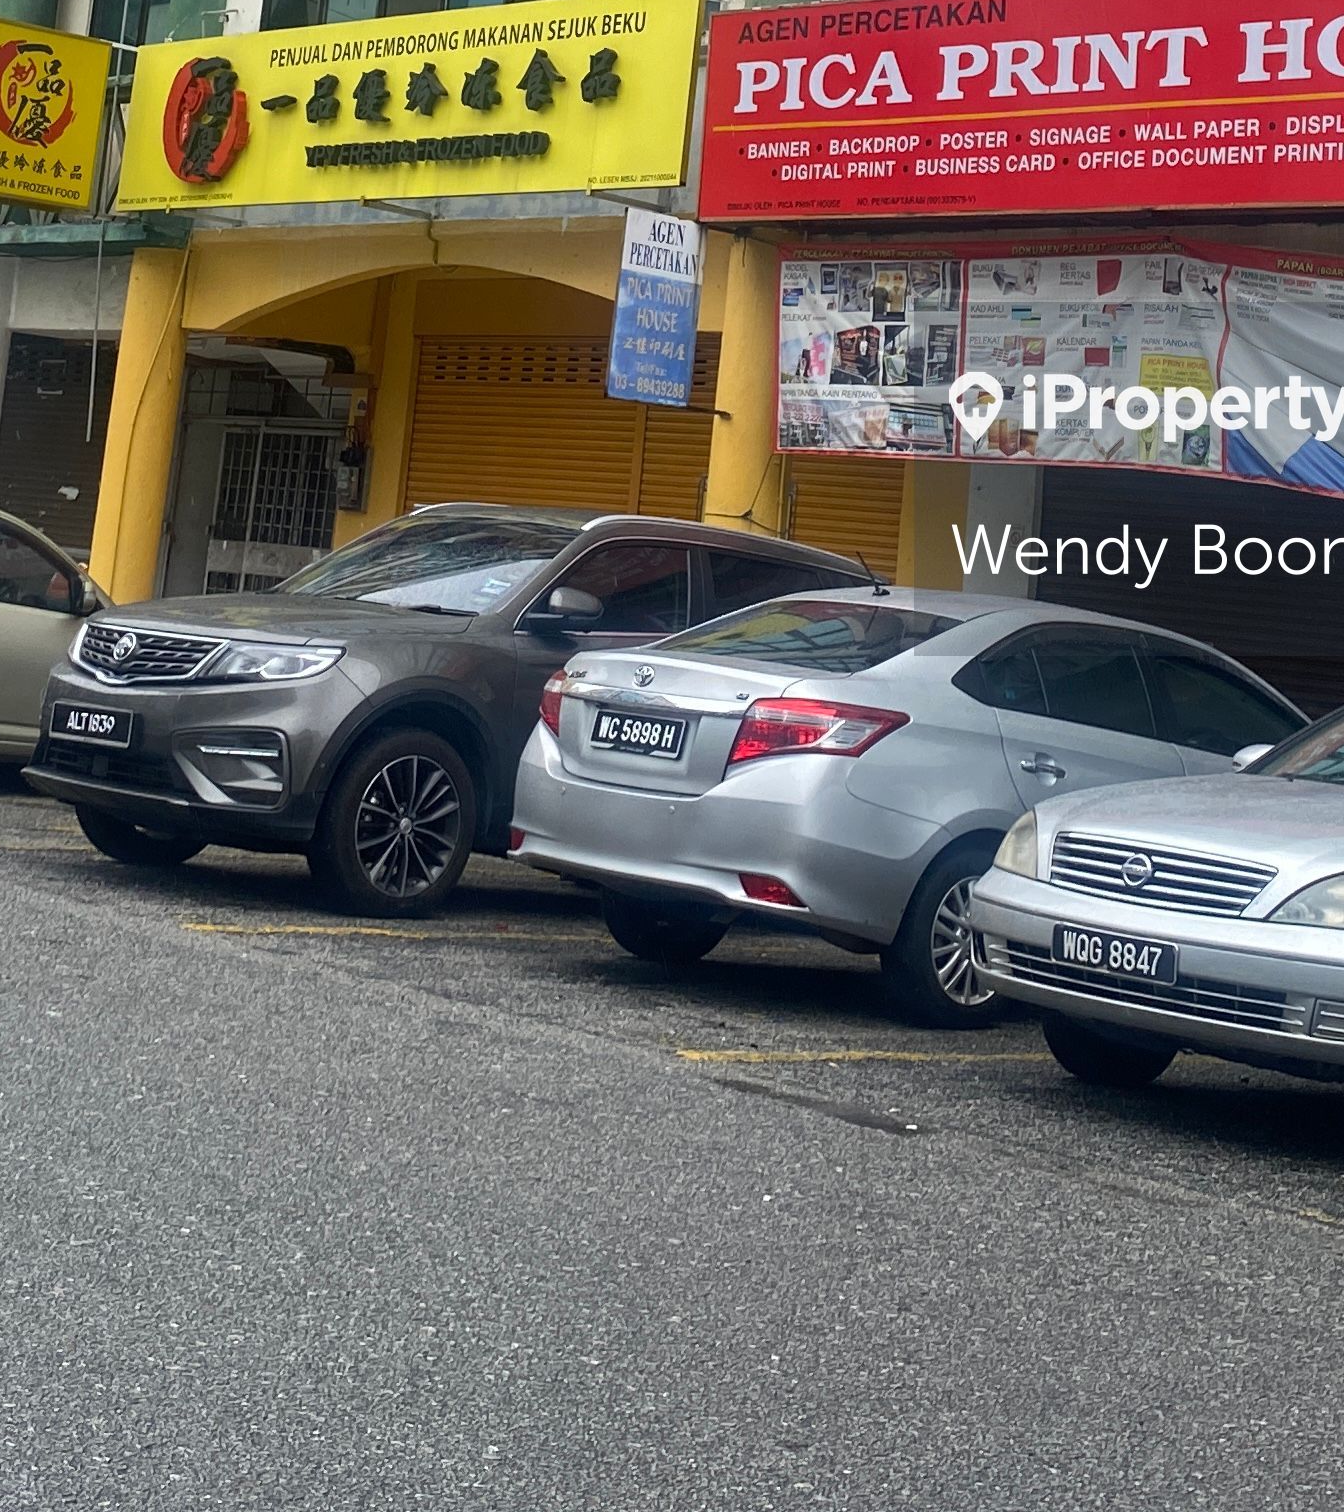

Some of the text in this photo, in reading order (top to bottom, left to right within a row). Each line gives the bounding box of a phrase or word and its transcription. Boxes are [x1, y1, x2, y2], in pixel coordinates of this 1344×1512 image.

[269, 11, 647, 69] PENJUAL DAN PEMBORONG MAKANAN SEJUK BEKU
[738, 15, 810, 44] AGEN
[733, 52, 913, 114] PICA
[937, 26, 1209, 102] PRINT
[337, 141, 394, 166] FRESH
[415, 134, 488, 162] FROZEN
[492, 130, 550, 157] FOOD
[747, 141, 811, 160] BANNER
[829, 136, 920, 156] BACKDROP
[939, 131, 1008, 151] POSTER
[1029, 125, 1111, 146] SIGNAGE
[1134, 122, 1187, 142] WALL
[1193, 119, 1261, 139] PAPER
[781, 164, 842, 181] DIGITAL
[847, 161, 896, 179] PRINT
[915, 156, 1000, 176] BUSINESS
[1005, 154, 1056, 173] CARD
[1077, 151, 1145, 170] OFFICE
[1152, 144, 1267, 167] DOCUMENT
[9, 179, 16, 188] &
[17, 180, 53, 196] FROZEN
[55, 187, 81, 200] FOOD
[648, 219, 687, 247] AGEN
[629, 242, 699, 277] PERCETAKAN
[1277, 259, 1314, 273] PAPAN
[627, 277, 693, 308] PICA PRINT
[636, 308, 678, 333] HOUSE
[1057, 337, 1096, 345] KALENDAR
[66, 710, 89, 731] ALT
[599, 716, 675, 749] WC 5898 H
[1063, 930, 1163, 977] WQG 8847
